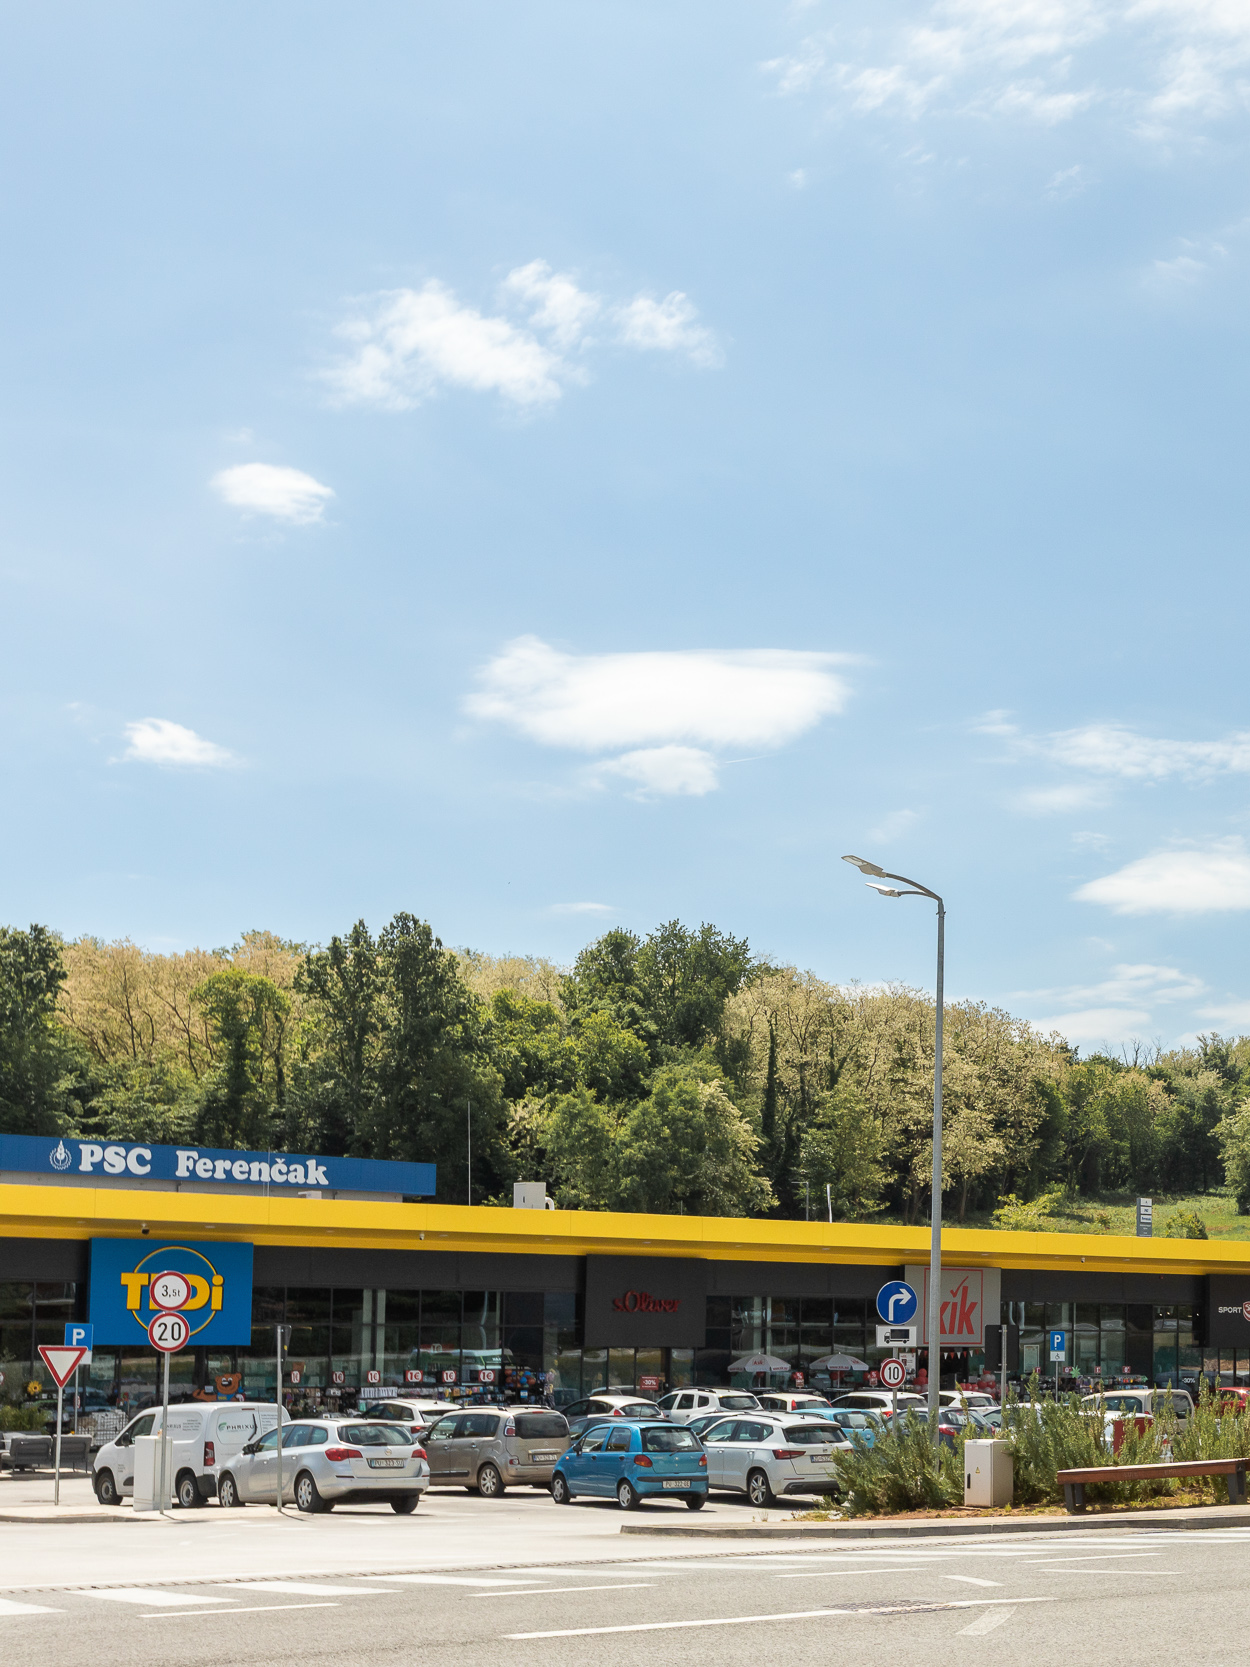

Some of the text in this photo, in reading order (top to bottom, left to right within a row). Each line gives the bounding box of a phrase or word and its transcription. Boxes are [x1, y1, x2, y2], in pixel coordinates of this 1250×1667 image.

[78, 1144, 329, 1186] PSC Ferenčak
[613, 1290, 683, 1313] s.Oliver
[1218, 1306, 1242, 1314] SPORT
[72, 1328, 85, 1345] P
[157, 1322, 182, 1341] 20
[1054, 1334, 1062, 1348] P
[409, 1371, 420, 1380] 1€
[482, 1371, 492, 1380] 1€
[888, 1366, 900, 1380] 10
